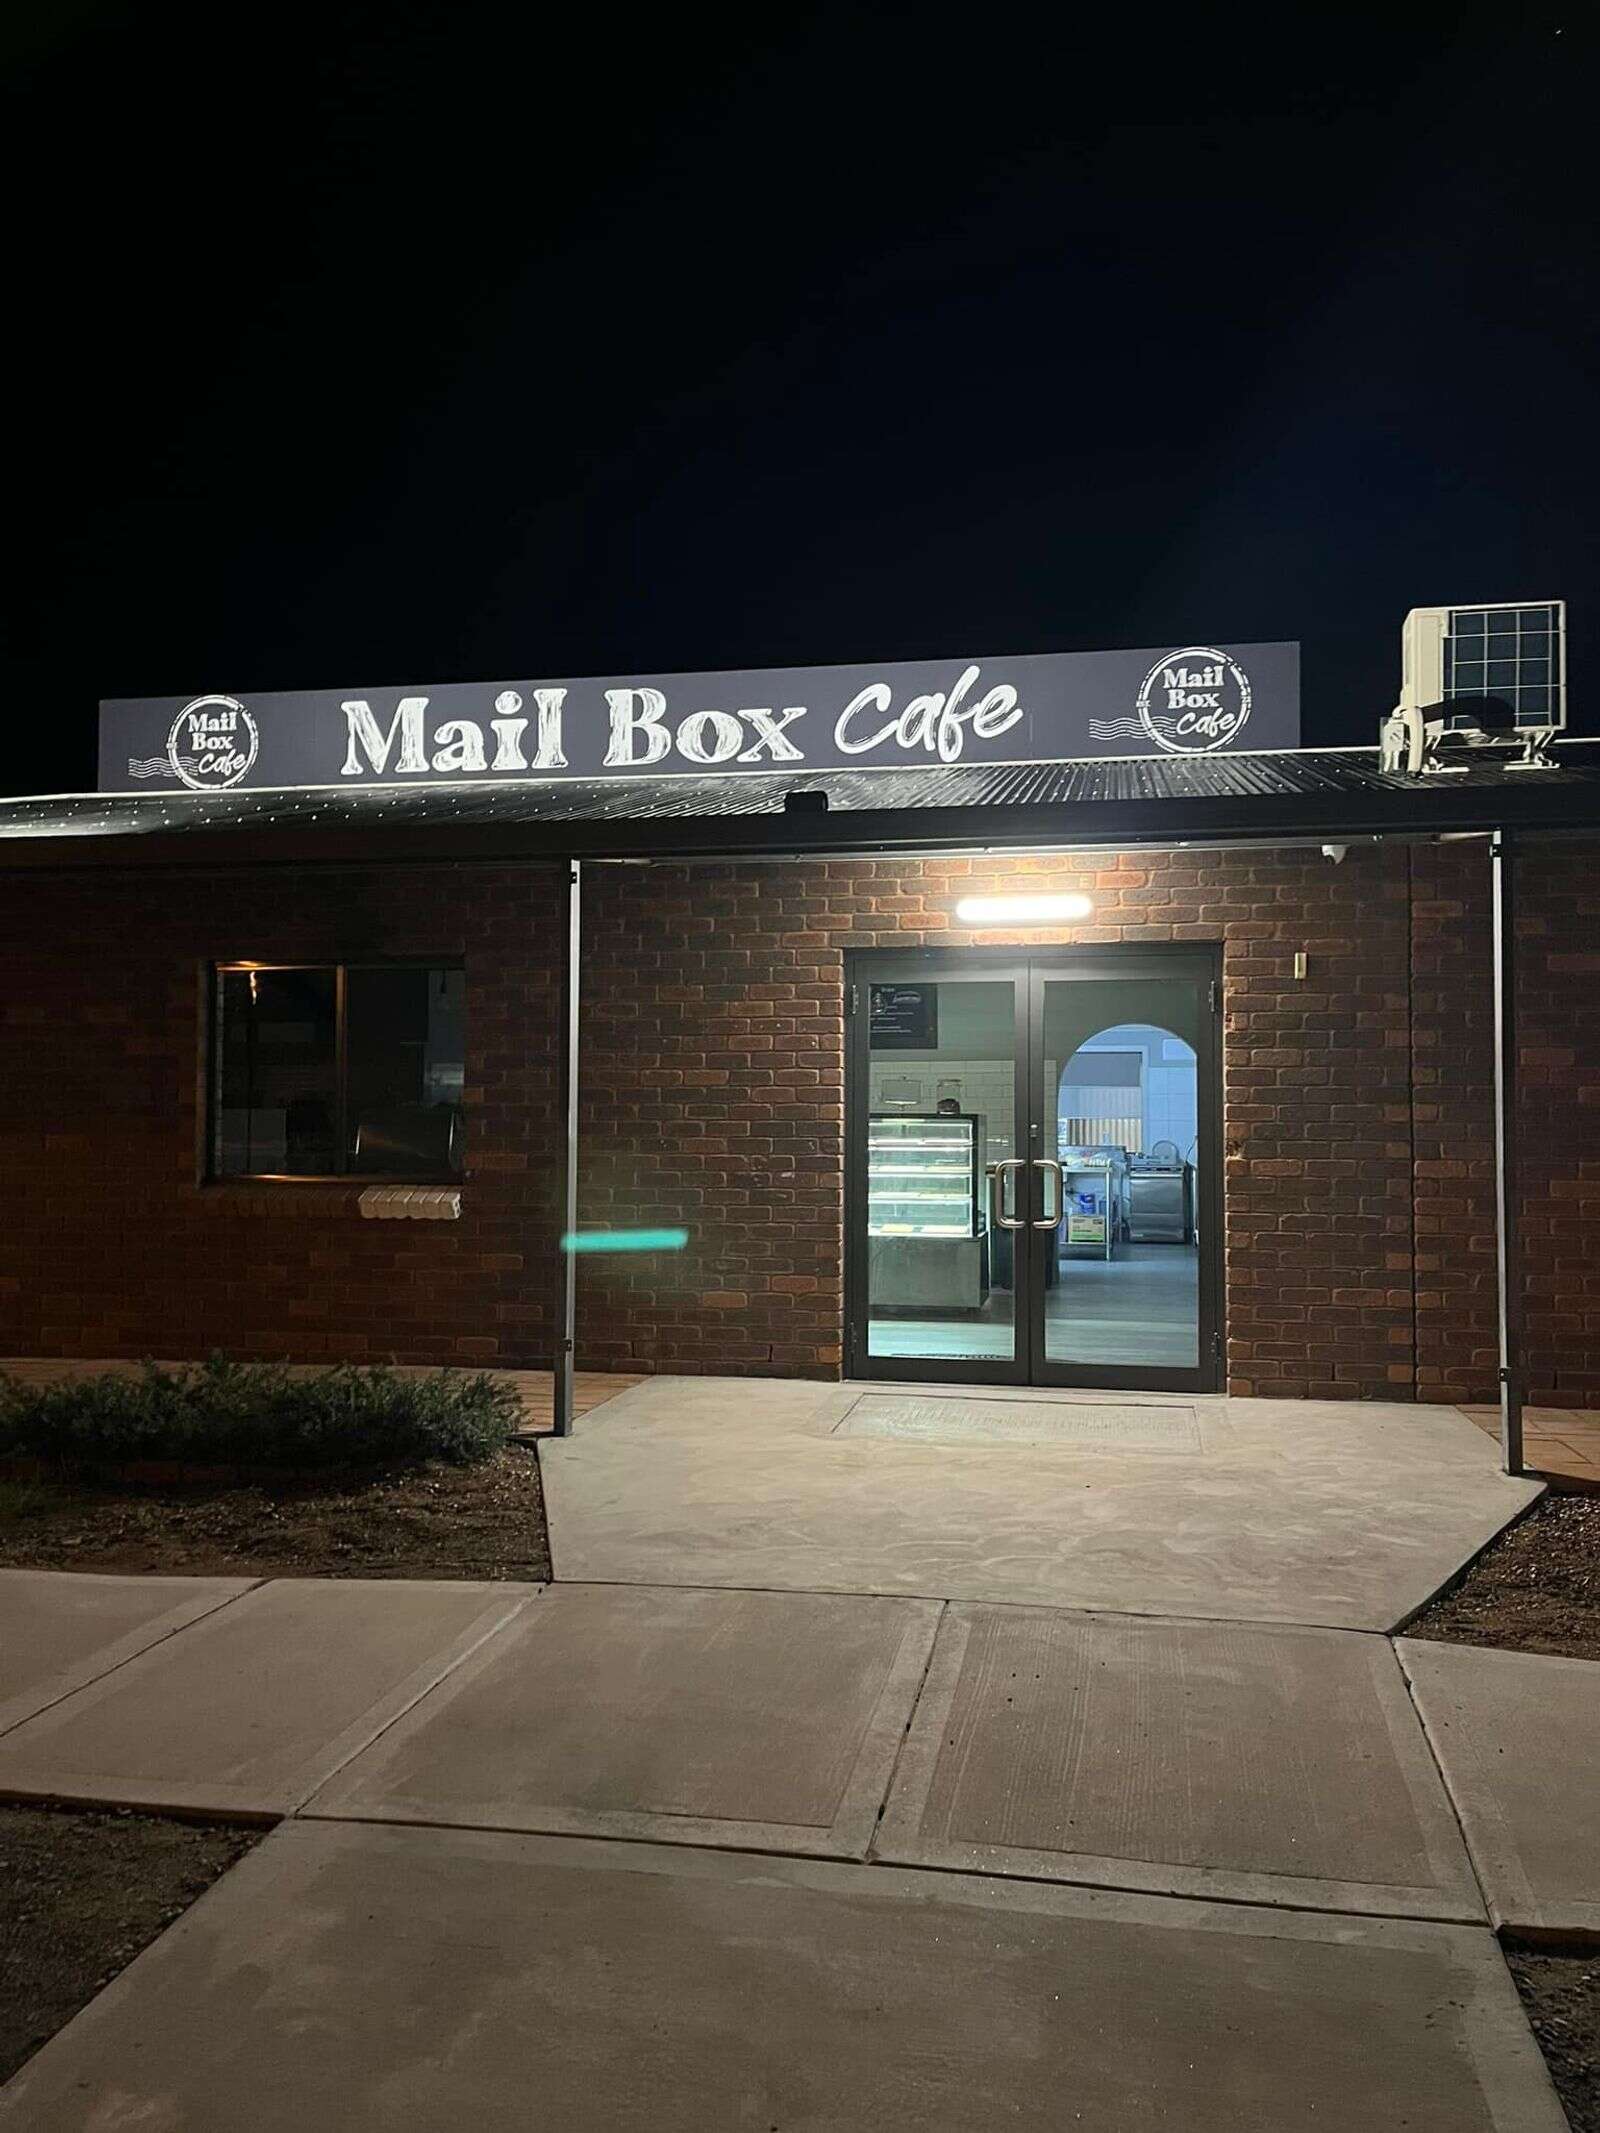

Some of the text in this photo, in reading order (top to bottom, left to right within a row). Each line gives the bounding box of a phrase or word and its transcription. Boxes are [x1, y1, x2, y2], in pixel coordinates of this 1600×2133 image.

[1162, 665, 1225, 688] Mail
[1167, 689, 1220, 709] Box
[188, 712, 238, 733] Mail
[340, 664, 1024, 775] Mail Box Cafe
[1175, 707, 1237, 737] Cafe
[191, 732, 234, 751] Box
[198, 748, 247, 776] Cafe
